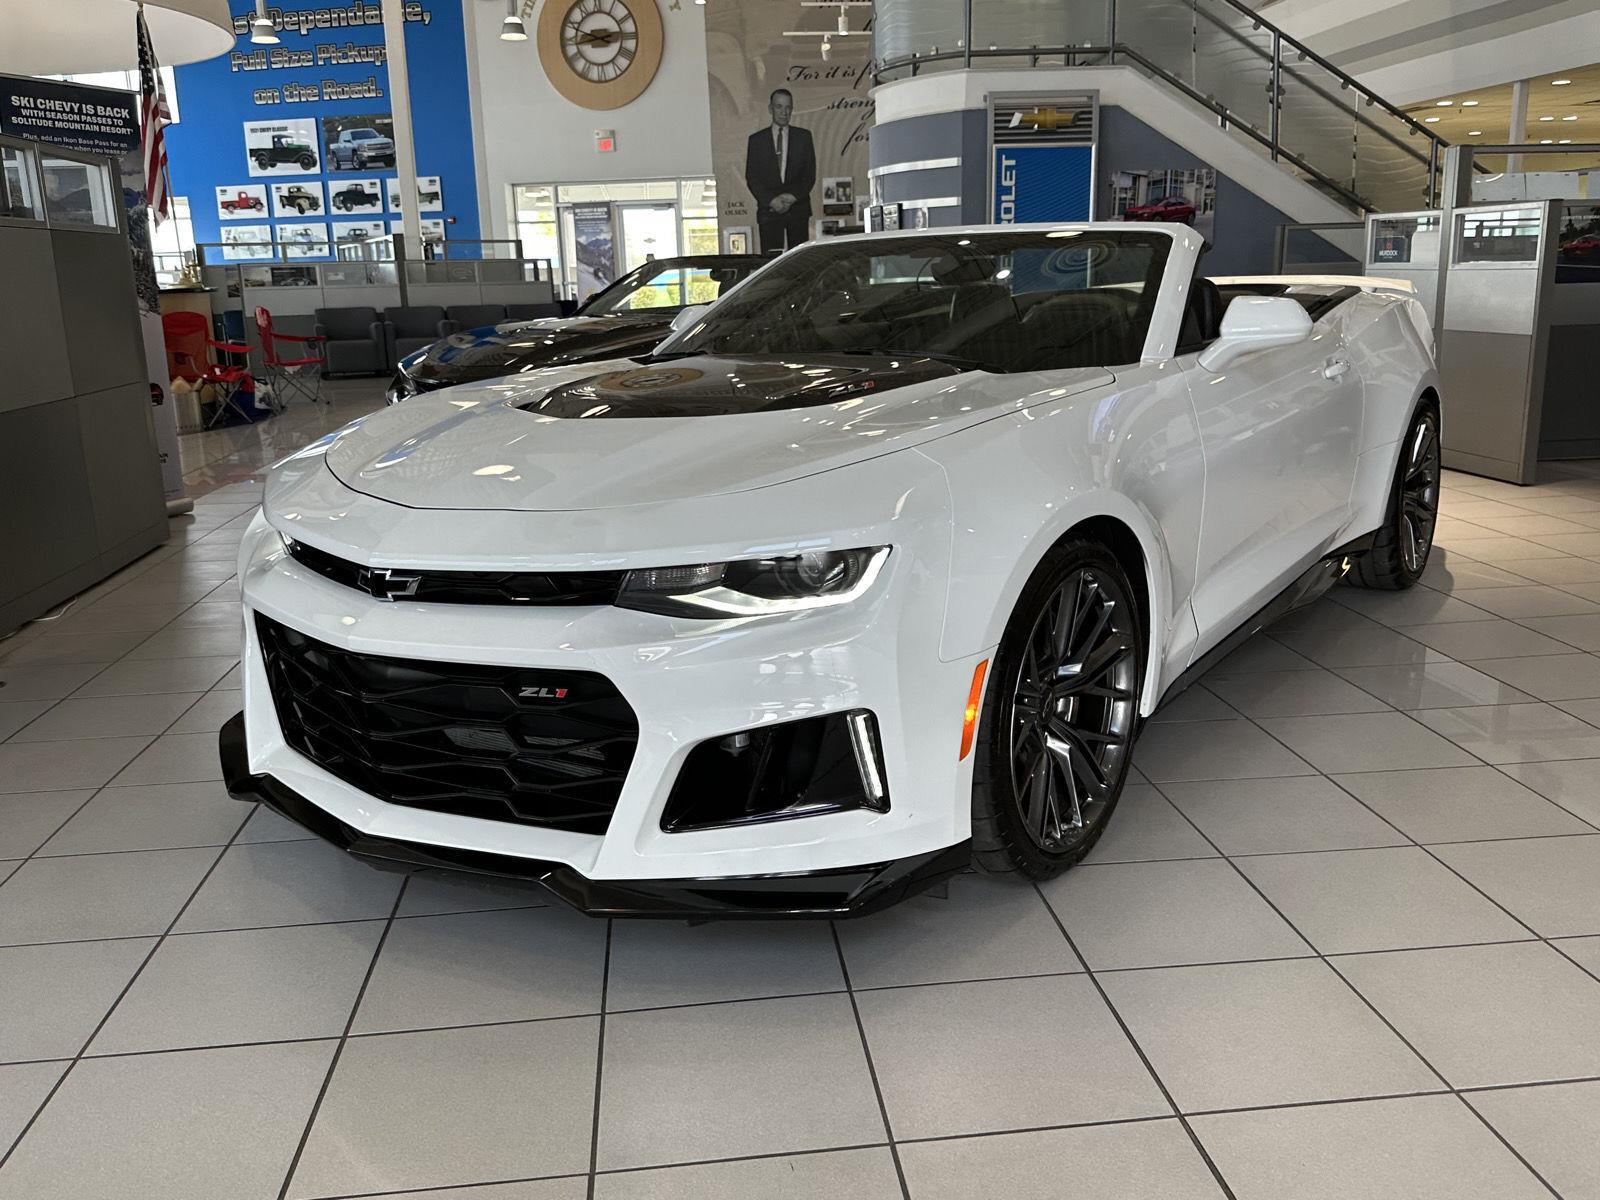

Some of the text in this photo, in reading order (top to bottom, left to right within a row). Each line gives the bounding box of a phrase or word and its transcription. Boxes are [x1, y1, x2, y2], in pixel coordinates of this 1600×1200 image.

[265, 1, 431, 35] Dependae,
[230, 43, 387, 72] Full Size Pickup
[254, 77, 383, 105] on the Road.
[11, 96, 130, 119] SKI CHEVY IS BACK
[21, 109, 45, 118] WITH
[46, 111, 80, 121] SEASON
[81, 115, 112, 125] PASSES
[12, 116, 54, 127] SOLITUDE
[55, 121, 99, 132] MOUNTAIN
[23, 132, 39, 141] Plus,
[518, 687, 568, 698] ZL1
